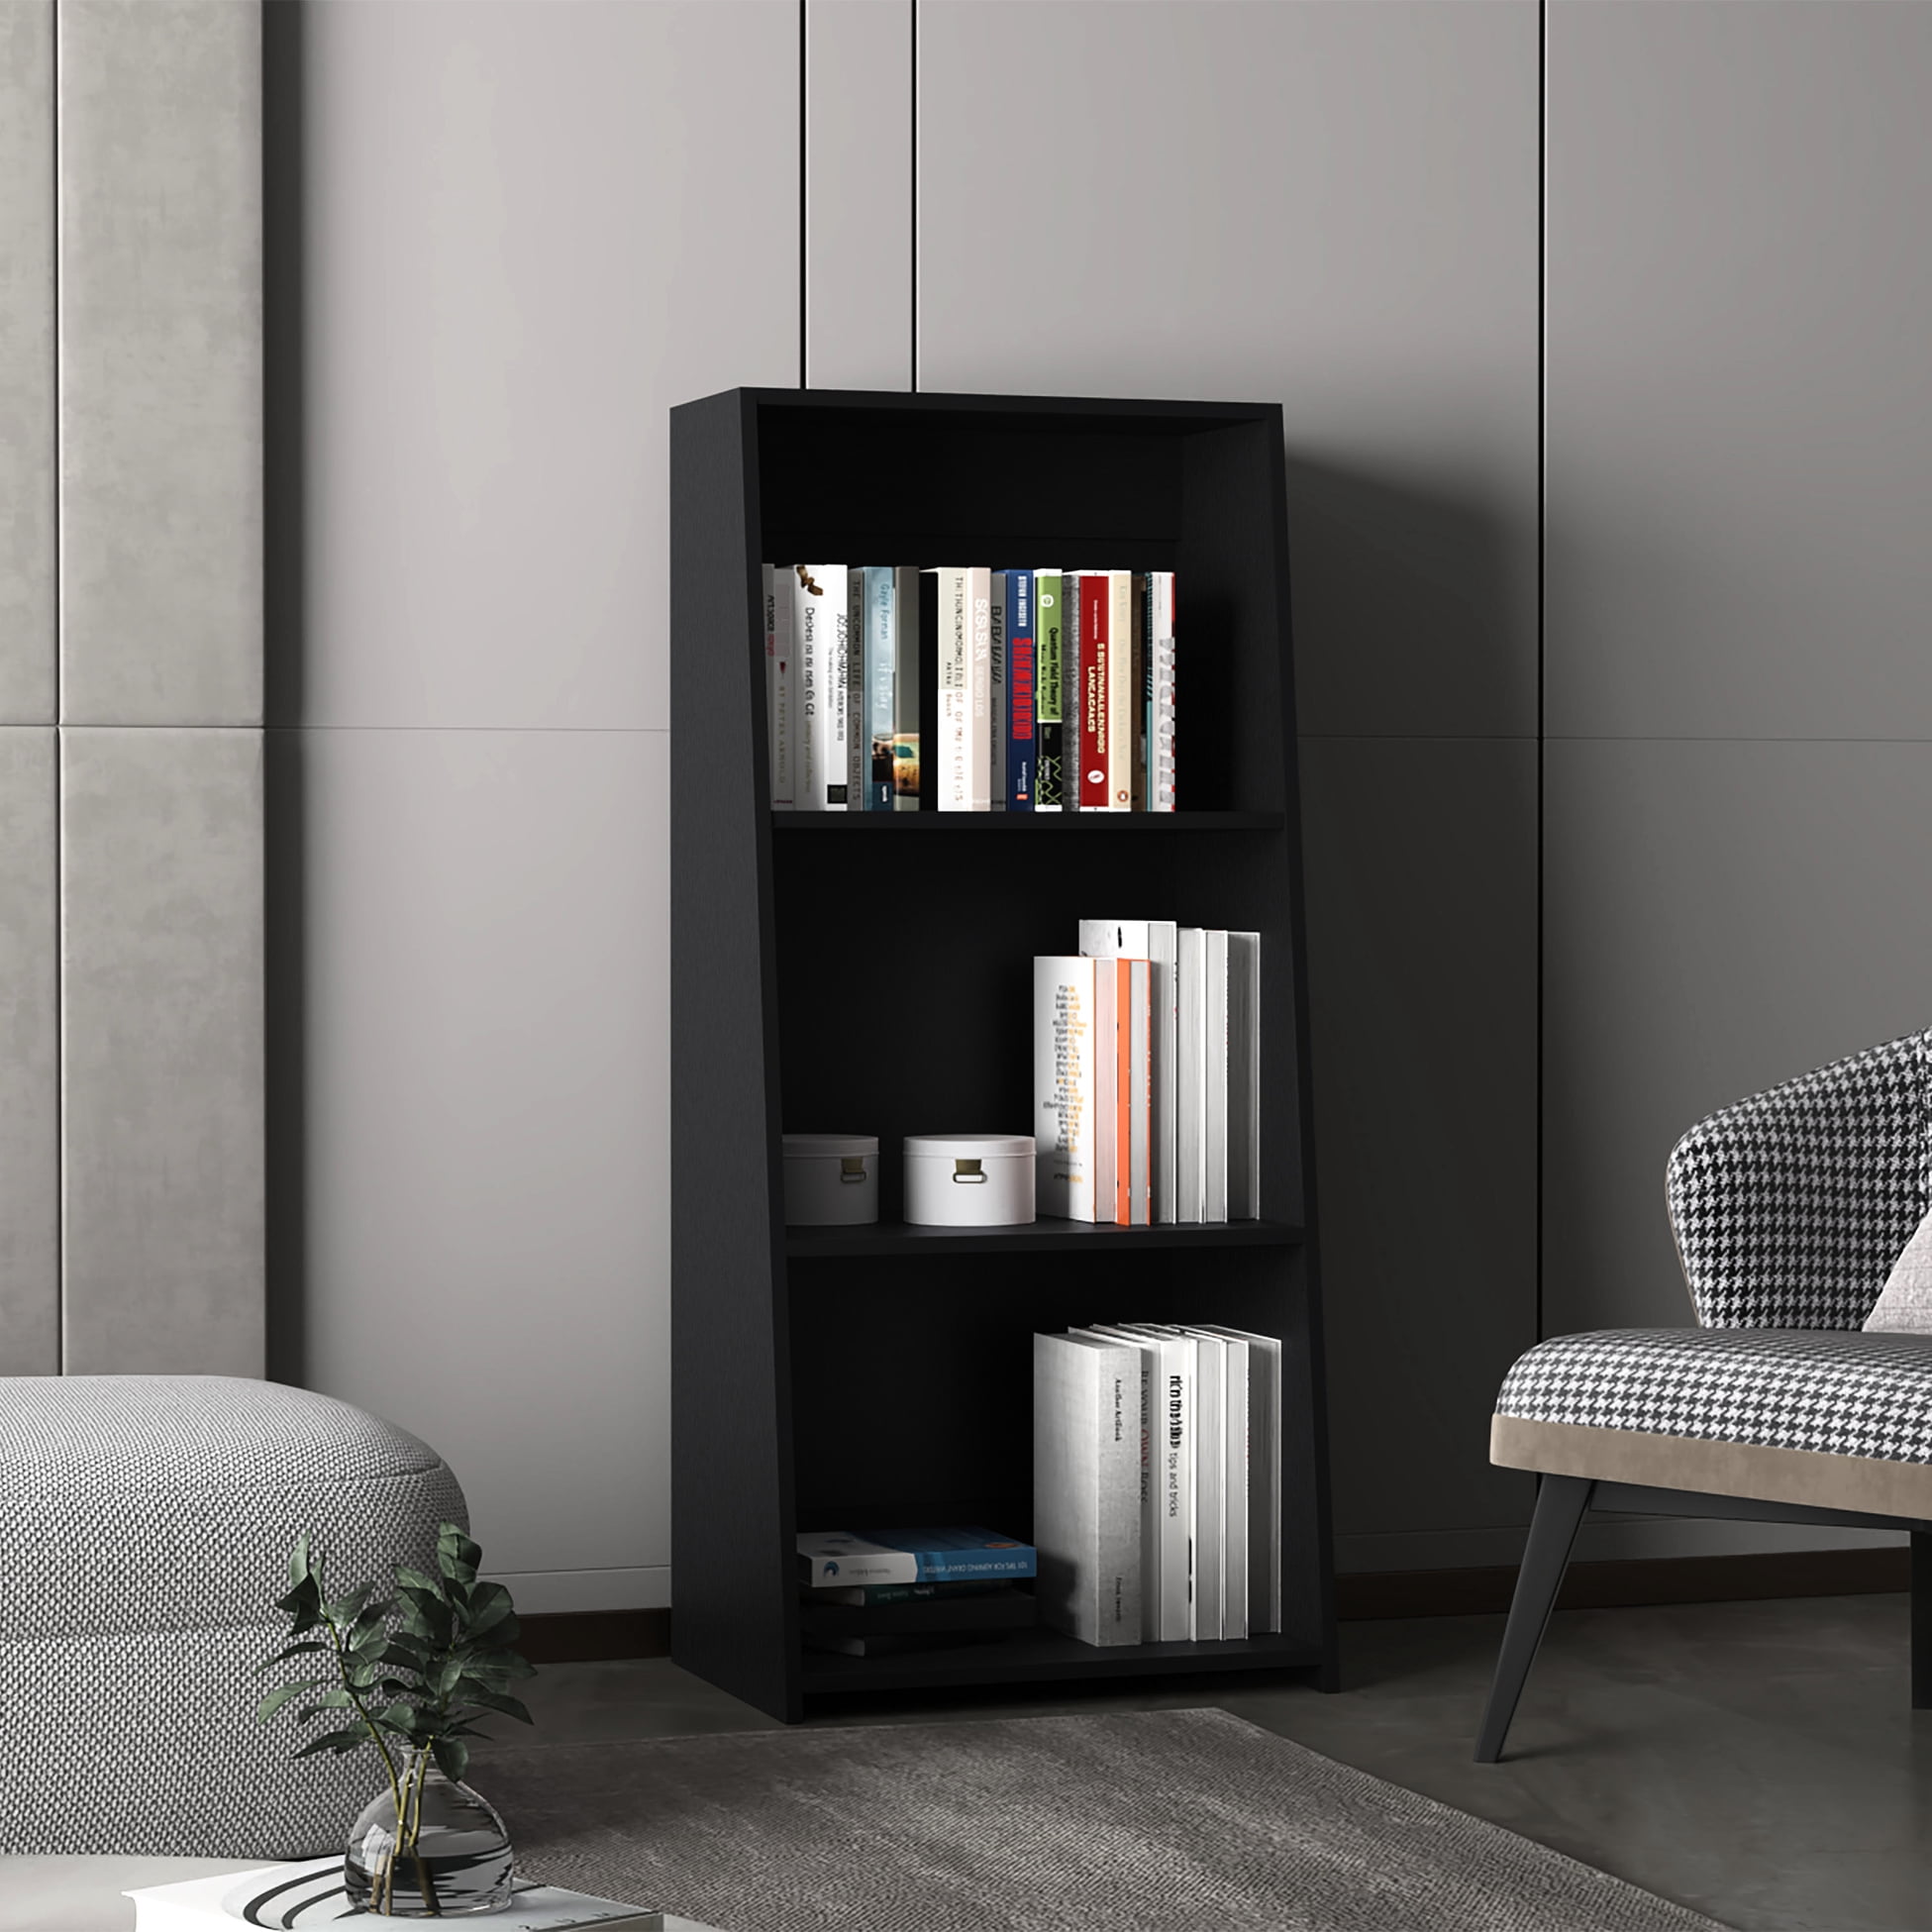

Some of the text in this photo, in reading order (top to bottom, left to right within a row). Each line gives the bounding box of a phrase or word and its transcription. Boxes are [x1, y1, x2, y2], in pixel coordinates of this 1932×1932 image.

[879, 583, 889, 640] Gayle Forman
[853, 693, 861, 704] OF
[1168, 1452, 1178, 1470] tips
[1169, 1473, 1179, 1489] and
[1169, 1491, 1179, 1517] tricks
